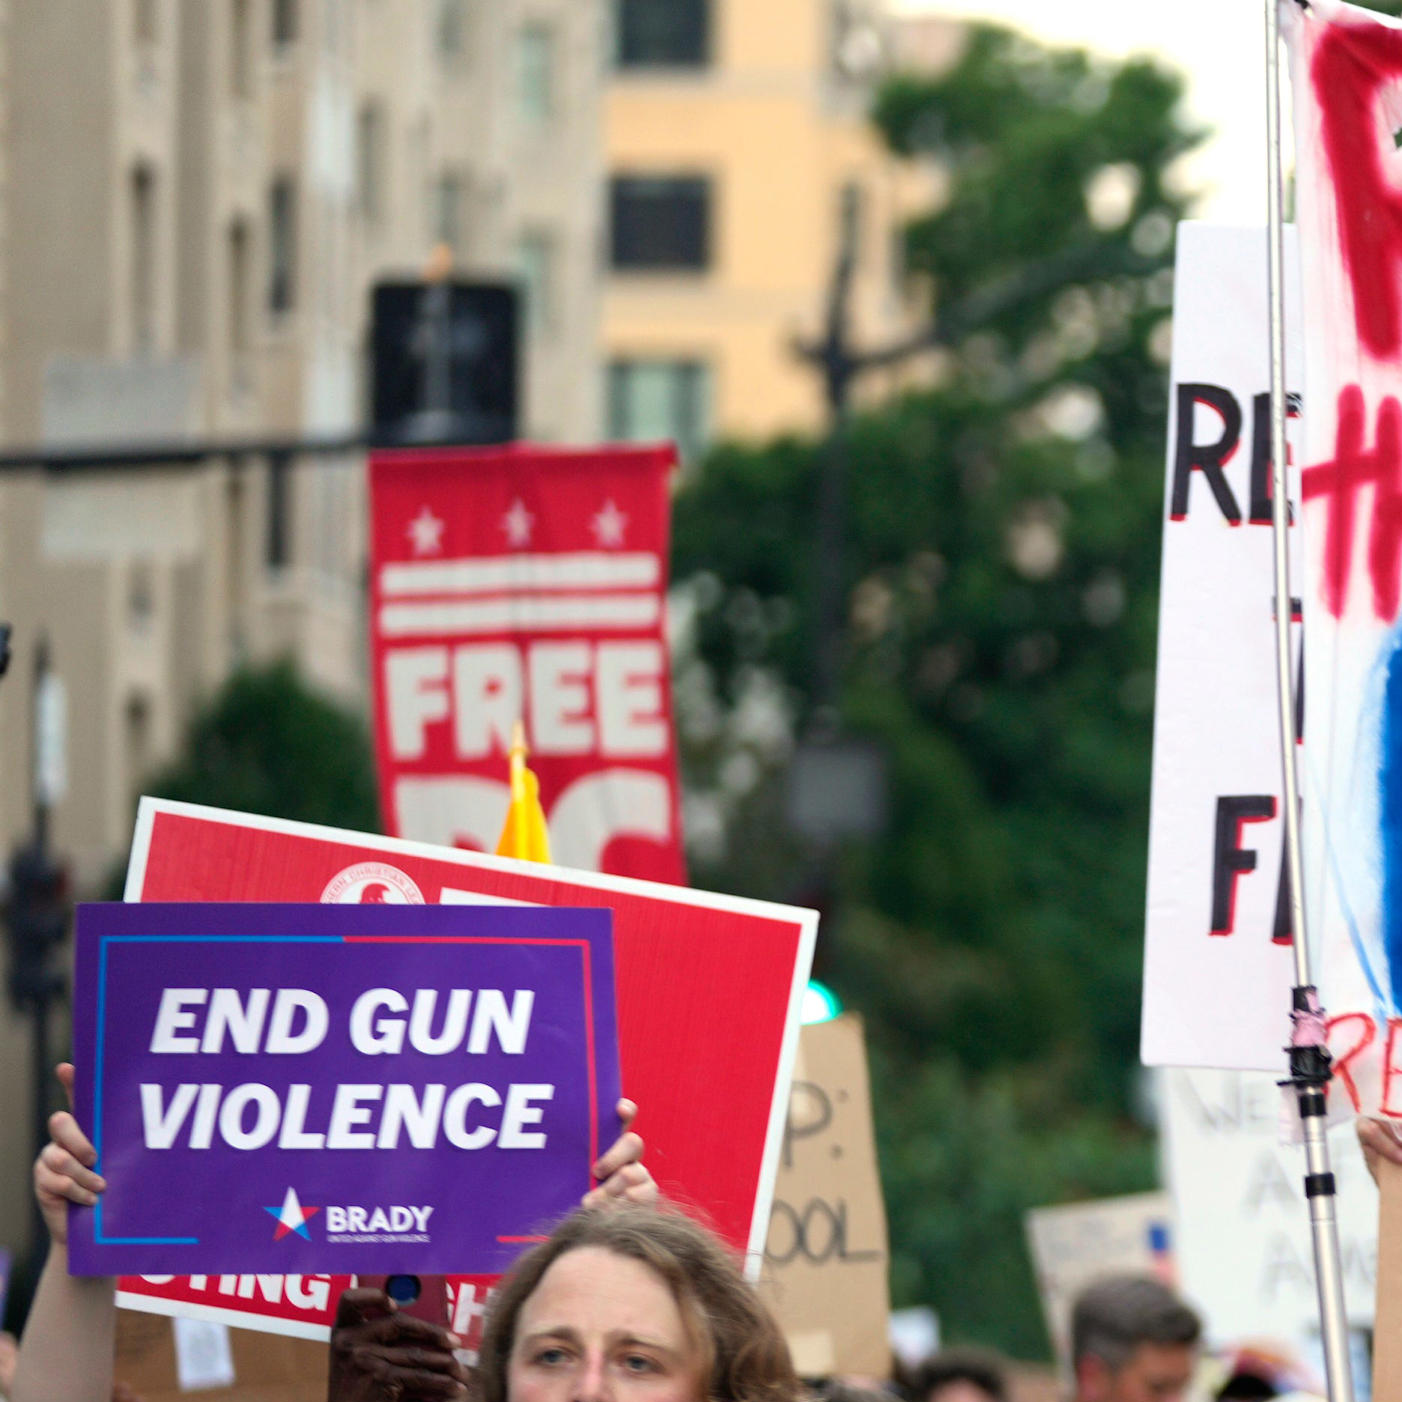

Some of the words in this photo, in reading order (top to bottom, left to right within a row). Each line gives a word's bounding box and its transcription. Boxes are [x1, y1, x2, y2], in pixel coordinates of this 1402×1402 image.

[384, 641, 669, 761] FREE
[149, 987, 329, 1055] END
[349, 986, 535, 1056] GUN
[138, 1082, 556, 1151] VIOLENCE
[325, 1205, 435, 1233] BRADY
